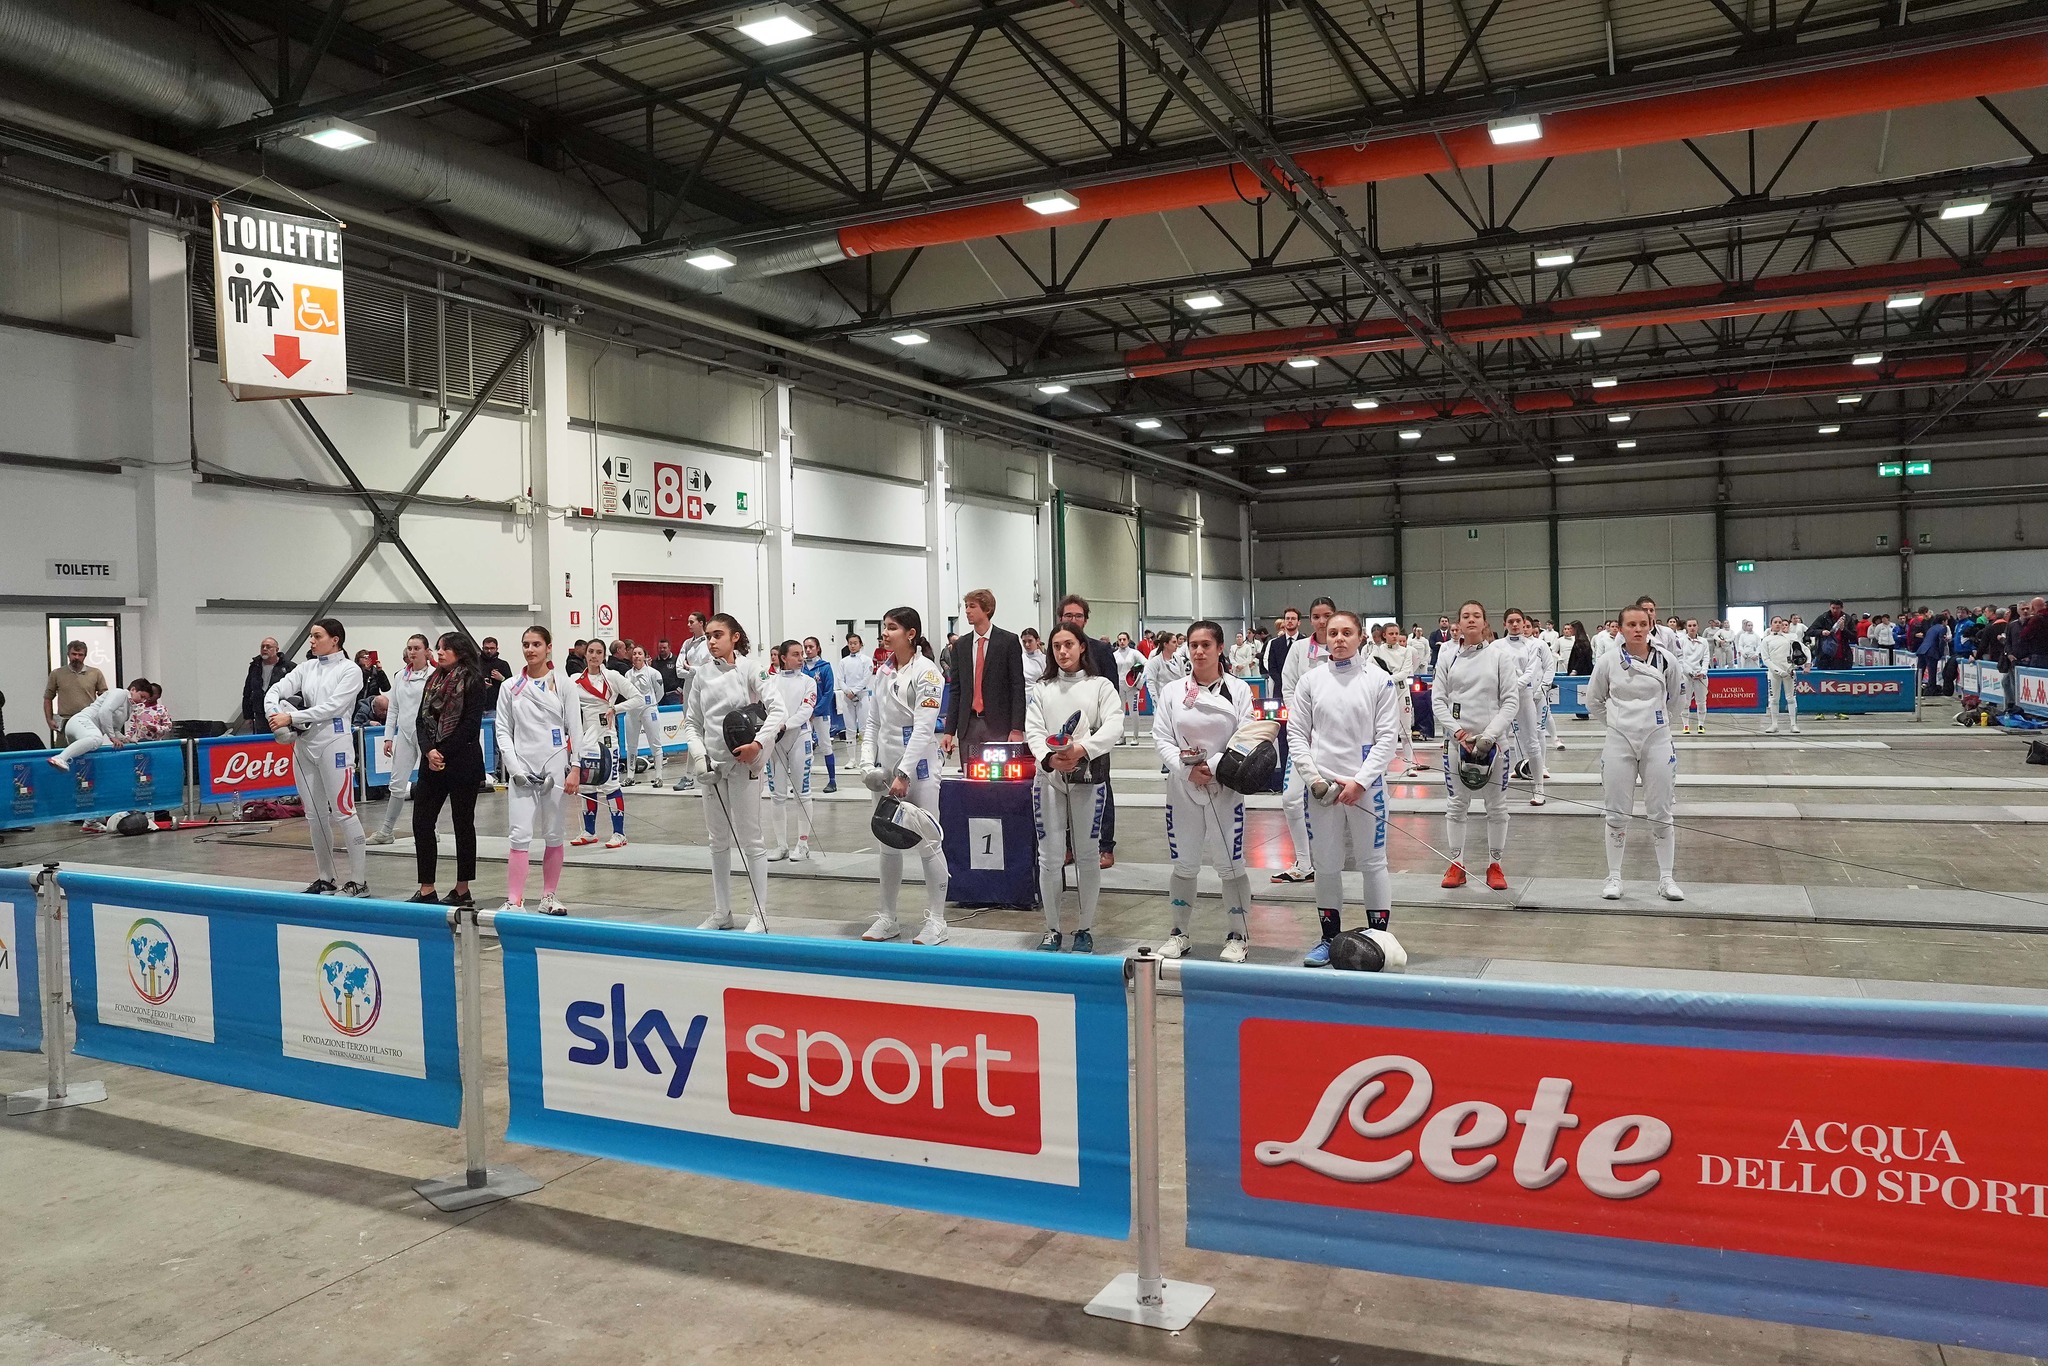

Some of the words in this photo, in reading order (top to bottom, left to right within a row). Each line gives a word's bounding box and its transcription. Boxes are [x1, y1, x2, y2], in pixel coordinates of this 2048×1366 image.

[222, 213, 340, 263] TOILETTE
[637, 495, 649, 509] WC
[657, 466, 682, 514] 8
[55, 563, 110, 577] TOILETTE
[1820, 680, 1898, 694] Kappa
[1281, 709, 1288, 719] 0
[213, 752, 290, 784] Lete
[611, 748, 619, 780] ITALIA
[983, 749, 1007, 762] 0:26
[1007, 764, 1022, 778] 14
[801, 758, 811, 793] ITALIA
[1034, 786, 1046, 839] ITALIA
[1090, 785, 1106, 838] ITALIA
[1374, 790, 1386, 849] ITALIA
[982, 833, 993, 854] 1
[1166, 804, 1179, 859] ITALIA
[1233, 803, 1244, 860] ITALIA
[115, 1004, 150, 1017] FONDAZIONE
[151, 1009, 169, 1019] TERZO
[169, 1013, 196, 1024] PILASTRO
[137, 1017, 174, 1028] INTERNAZIONALE
[302, 1035, 345, 1049] FONDAZIONE
[346, 1042, 369, 1052] TERZO
[369, 1046, 403, 1057] PILASTRO
[328, 1049, 375, 1062] INTERNAZIONALE
[565, 983, 708, 1098] sky
[745, 1024, 1015, 1117] sport
[1254, 1054, 1673, 1200] Lete
[1778, 1118, 1965, 1165] ACQUA
[1697, 1154, 1868, 1199] DELLO
[1877, 1168, 2048, 1220] SPORT
